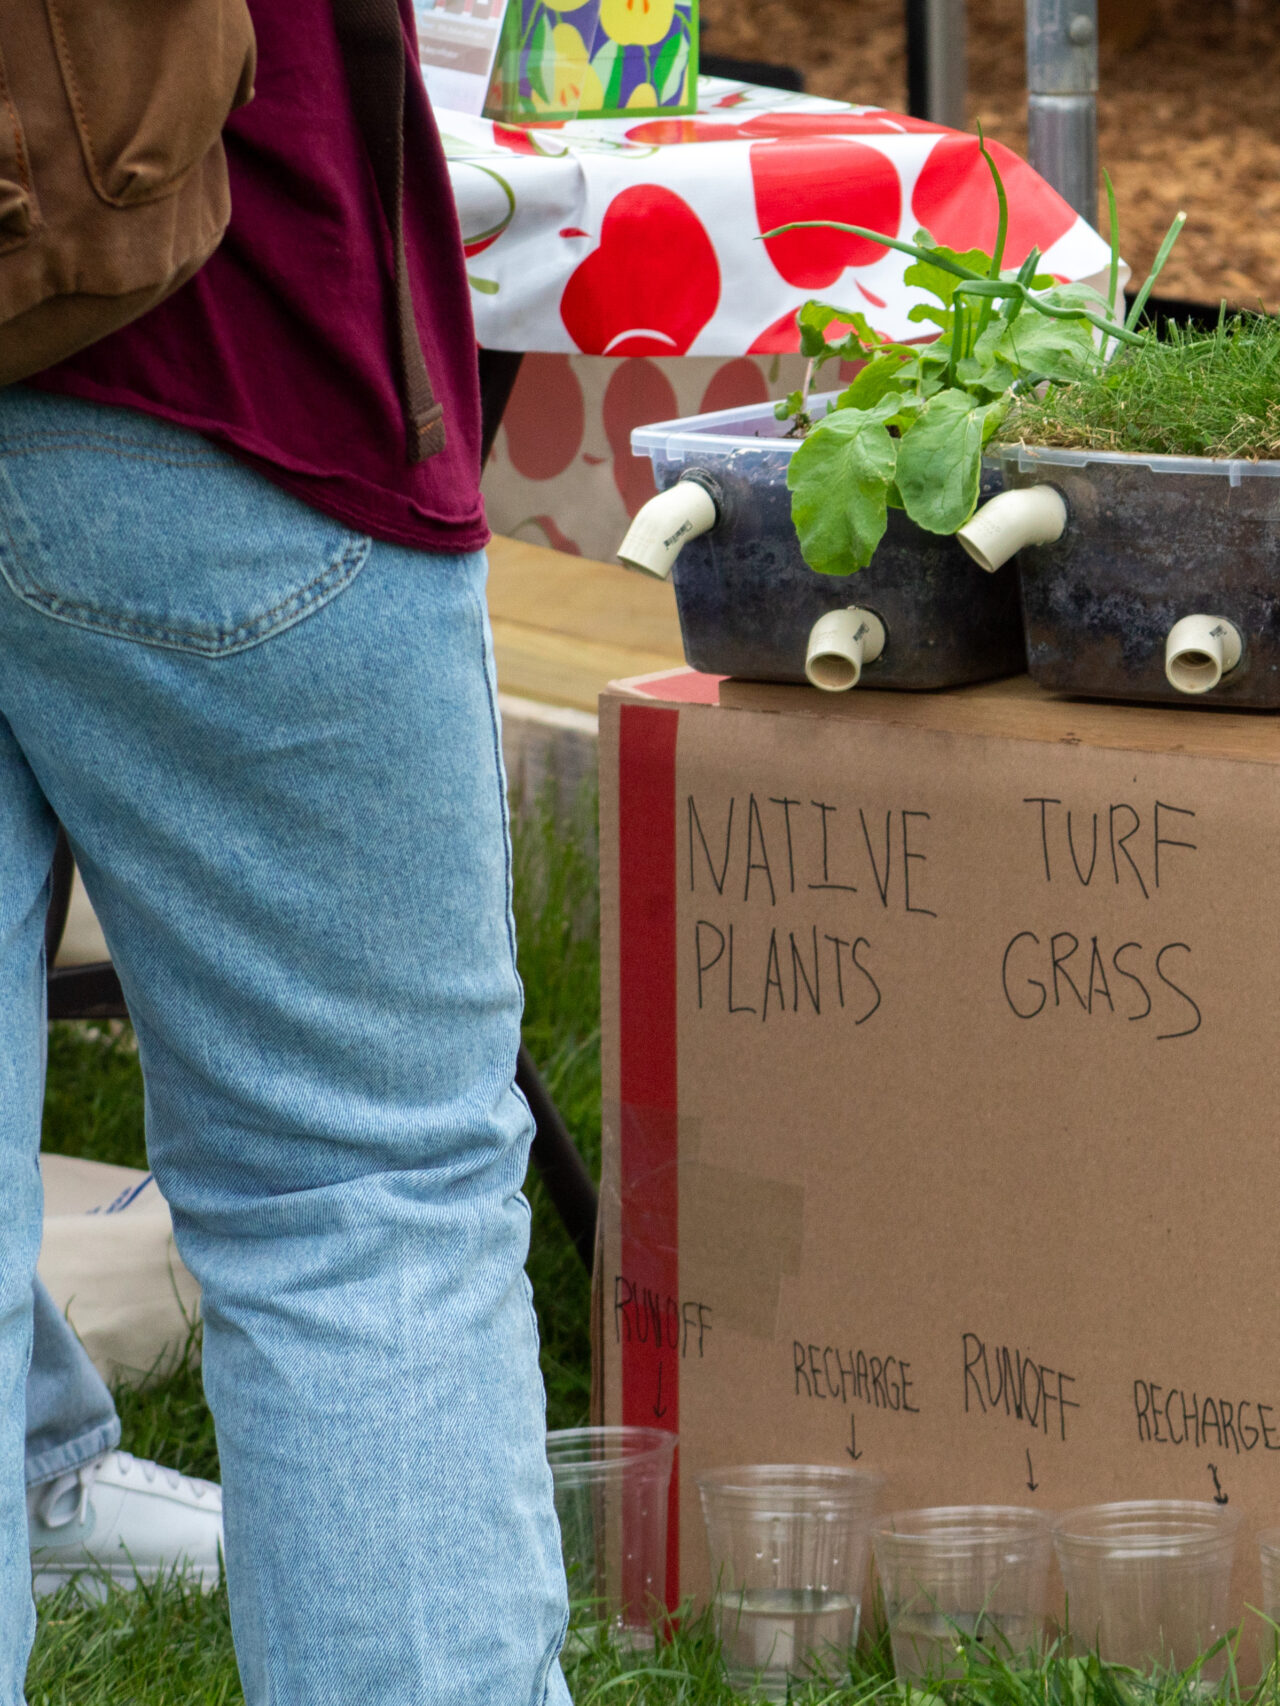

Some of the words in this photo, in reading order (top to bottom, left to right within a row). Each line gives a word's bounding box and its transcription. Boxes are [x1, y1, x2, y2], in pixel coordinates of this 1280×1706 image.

[688, 793, 938, 917] NATIVE
[1023, 798, 1197, 899] TURF
[695, 920, 881, 1025] PLANTS
[1002, 931, 1202, 1040] GRASS
[613, 1275, 713, 1359] RUNOFF
[793, 1340, 920, 1413] RECHARGE
[962, 1332, 1081, 1441] RUNOFF
